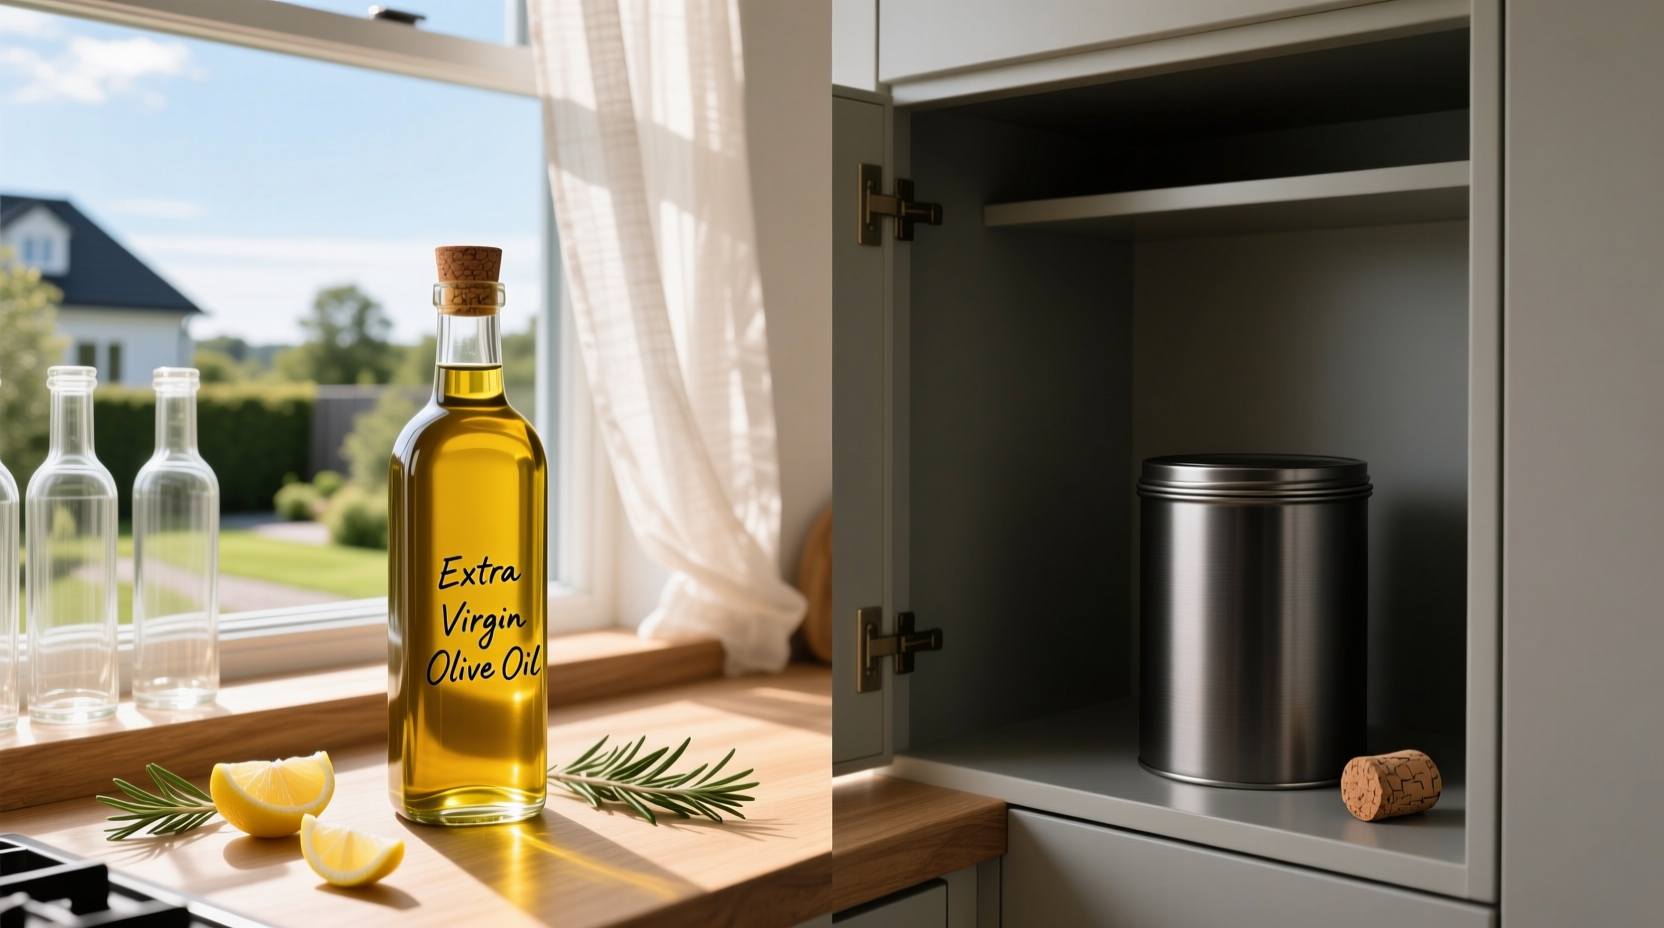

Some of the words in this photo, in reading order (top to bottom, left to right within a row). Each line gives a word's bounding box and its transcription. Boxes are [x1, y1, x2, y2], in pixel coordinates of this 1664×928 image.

[438, 555, 522, 590] Extra
[442, 601, 527, 650] Virgin
[426, 649, 495, 686] Olive
[502, 644, 541, 681] Oil
